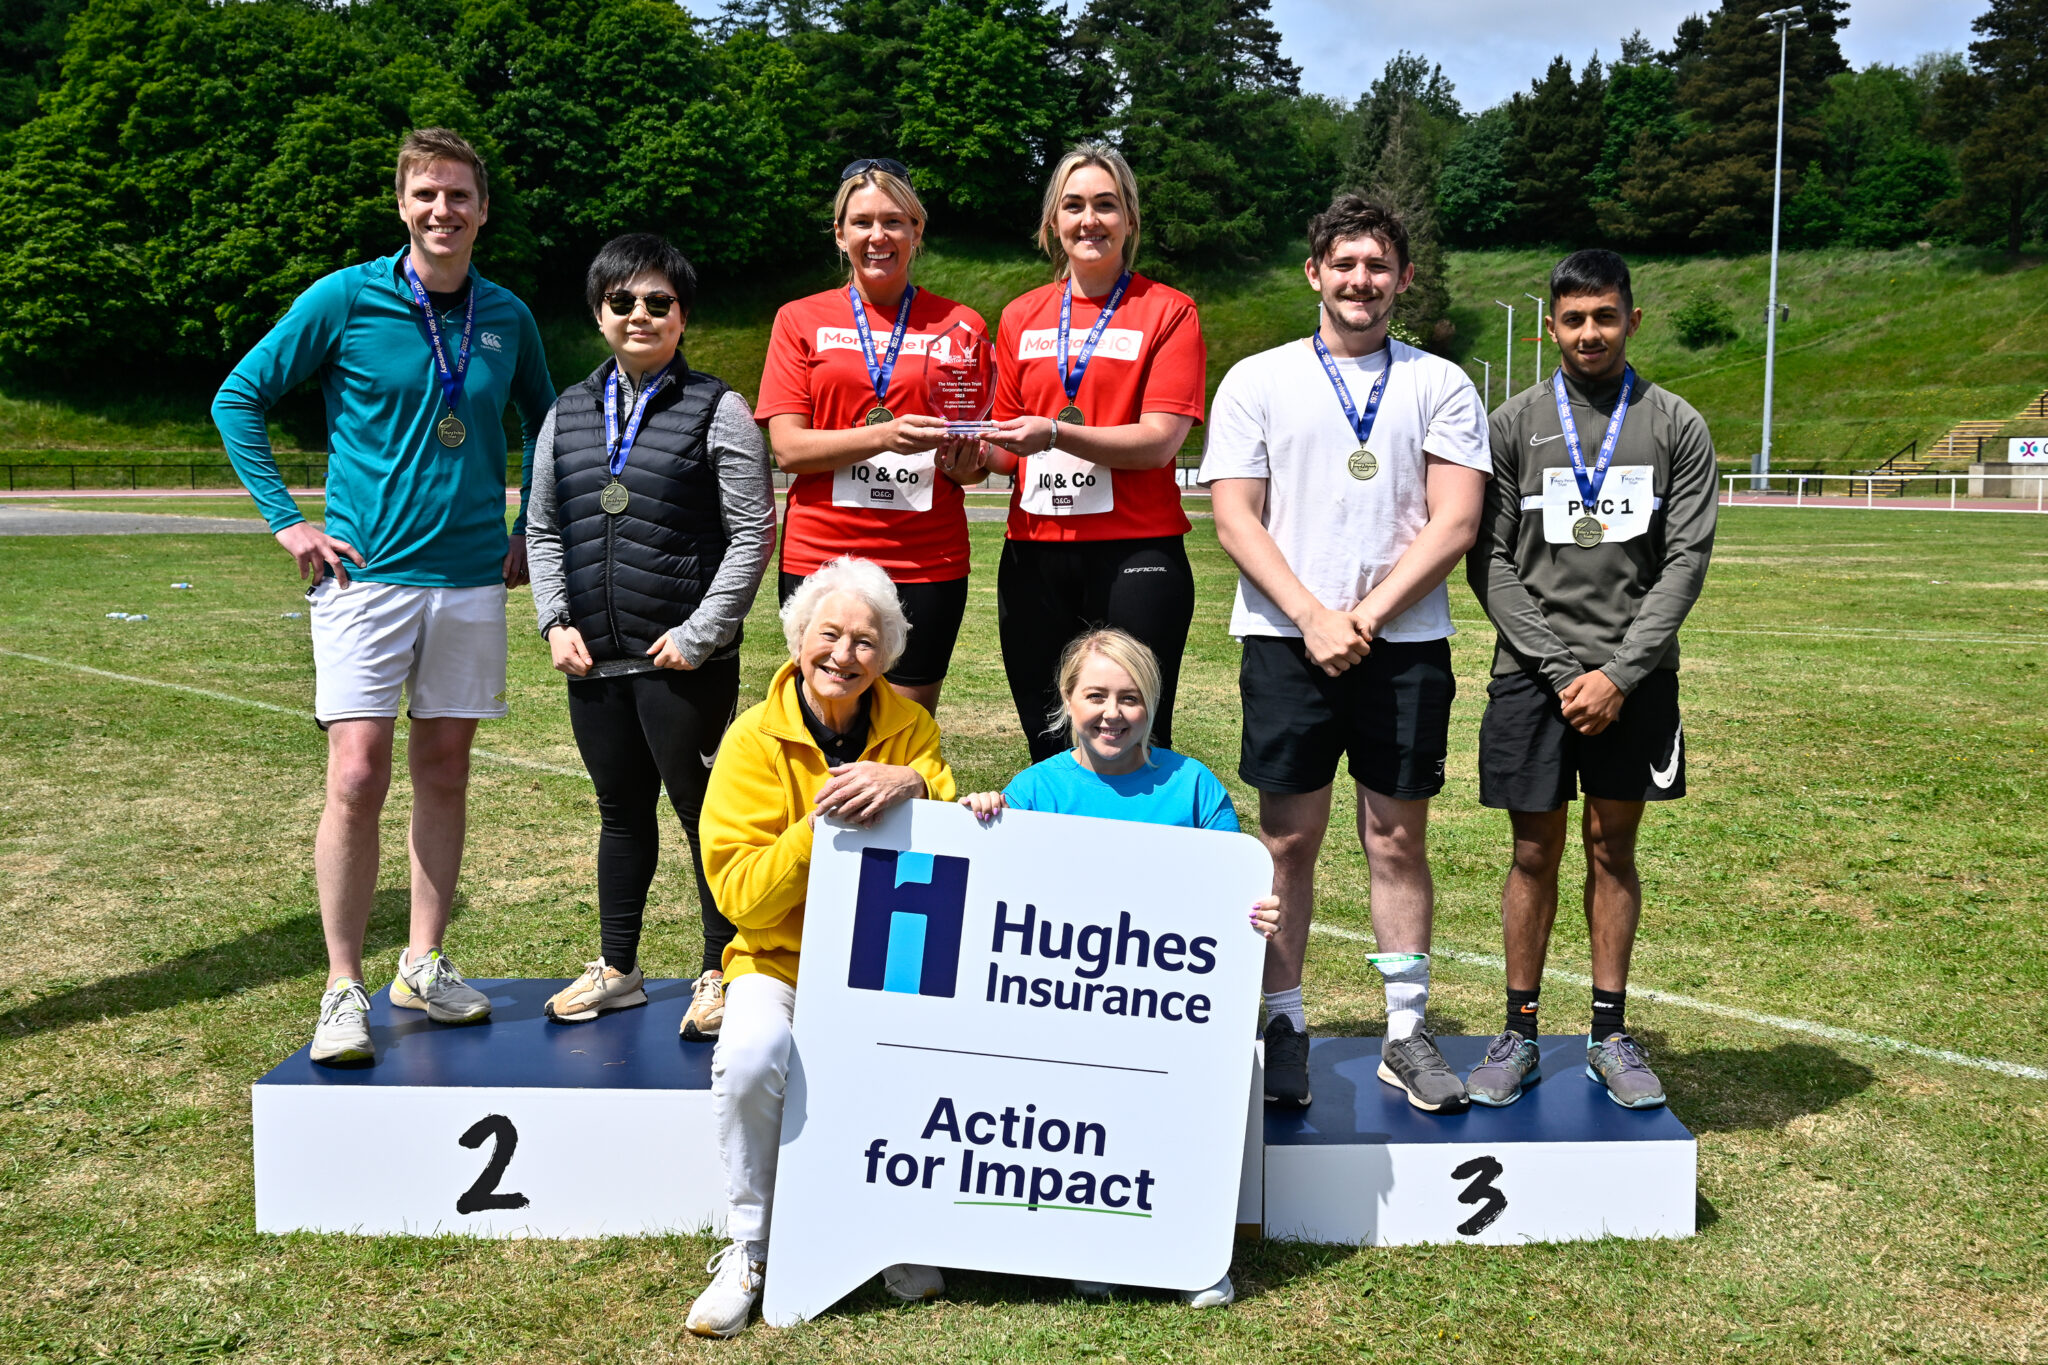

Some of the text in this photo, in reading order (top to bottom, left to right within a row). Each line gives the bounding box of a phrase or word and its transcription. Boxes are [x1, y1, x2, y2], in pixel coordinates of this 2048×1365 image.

[414, 281, 425, 296] 1972
[424, 302, 434, 318] 2022
[429, 319, 437, 334] 50th
[433, 335, 448, 373] Anniversary
[1079, 349, 1090, 363] 1972
[1089, 331, 1099, 344] 2022
[1096, 319, 1105, 330] 50th
[1103, 288, 1123, 318] Anniversary
[1369, 391, 1379, 404] 1972
[1561, 403, 1570, 418] 2022
[1565, 418, 1573, 432] 50th
[1597, 456, 1607, 471] 1972
[1603, 435, 1614, 450] 2022
[1609, 421, 1619, 434] 50th
[1614, 384, 1630, 420] Anniversary
[852, 465, 919, 484] IQ & Co
[1040, 472, 1096, 491] IQ & Co
[1568, 433, 1583, 469] Anniversary
[1621, 498, 1634, 514] 1
[991, 900, 1218, 980] Hughes
[986, 962, 1212, 1024] Insurance
[920, 1096, 1106, 1157] Action
[456, 1114, 530, 1215] 2
[864, 1138, 1156, 1212] for Impact
[1450, 1155, 1508, 1236] 3
